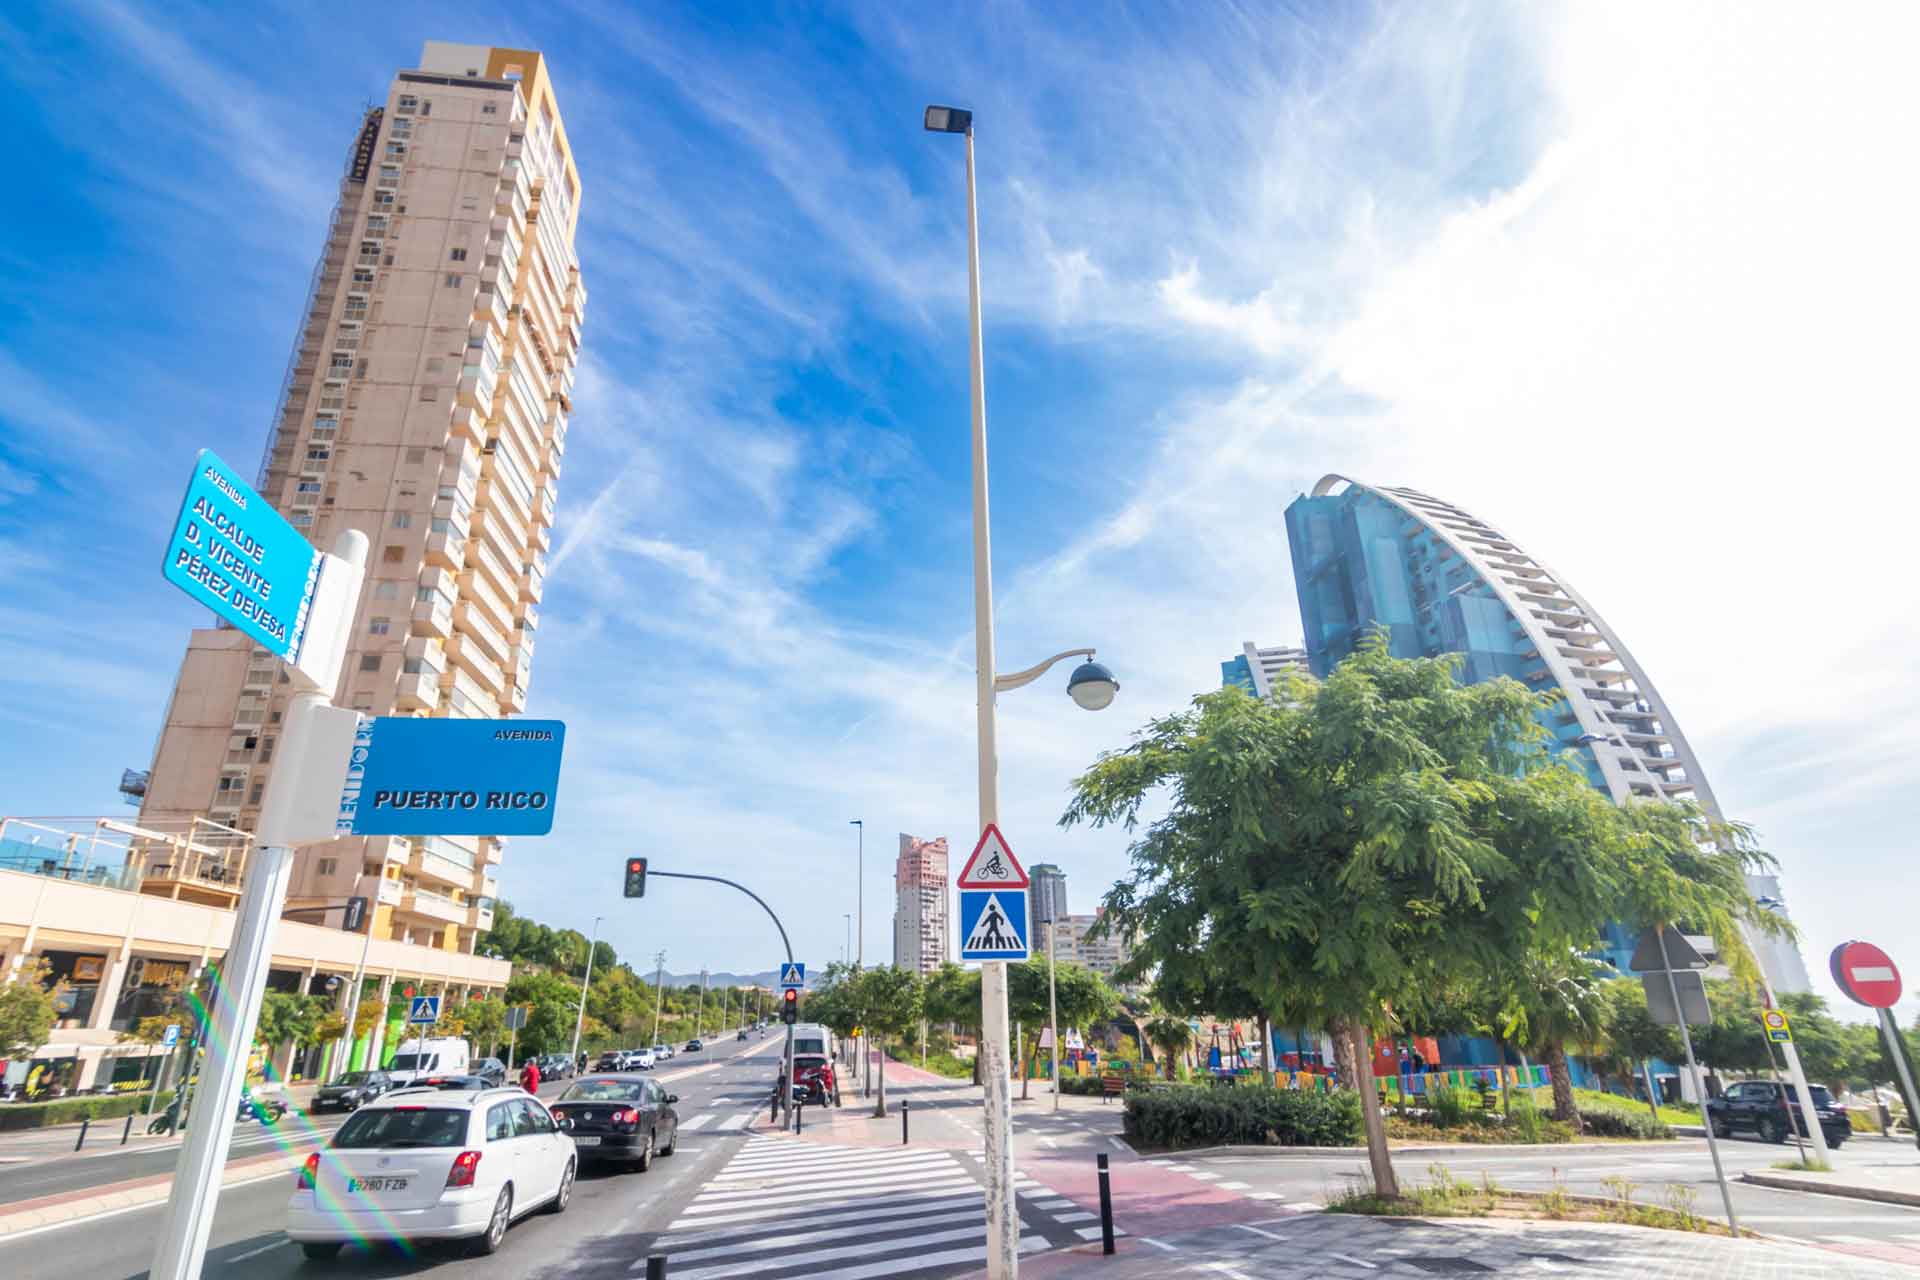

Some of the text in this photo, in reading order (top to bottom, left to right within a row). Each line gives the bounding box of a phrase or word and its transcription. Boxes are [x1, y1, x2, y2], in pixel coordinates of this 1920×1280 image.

[204, 466, 246, 510] AVENIDA
[185, 521, 272, 600] D. VICENTE
[193, 496, 265, 564] ALCALDE
[176, 547, 287, 642] PÉREZ DEVESA
[494, 729, 555, 742] AVENIDA
[336, 711, 376, 836] BENIDORM
[374, 790, 548, 810] PUERTO RICO
